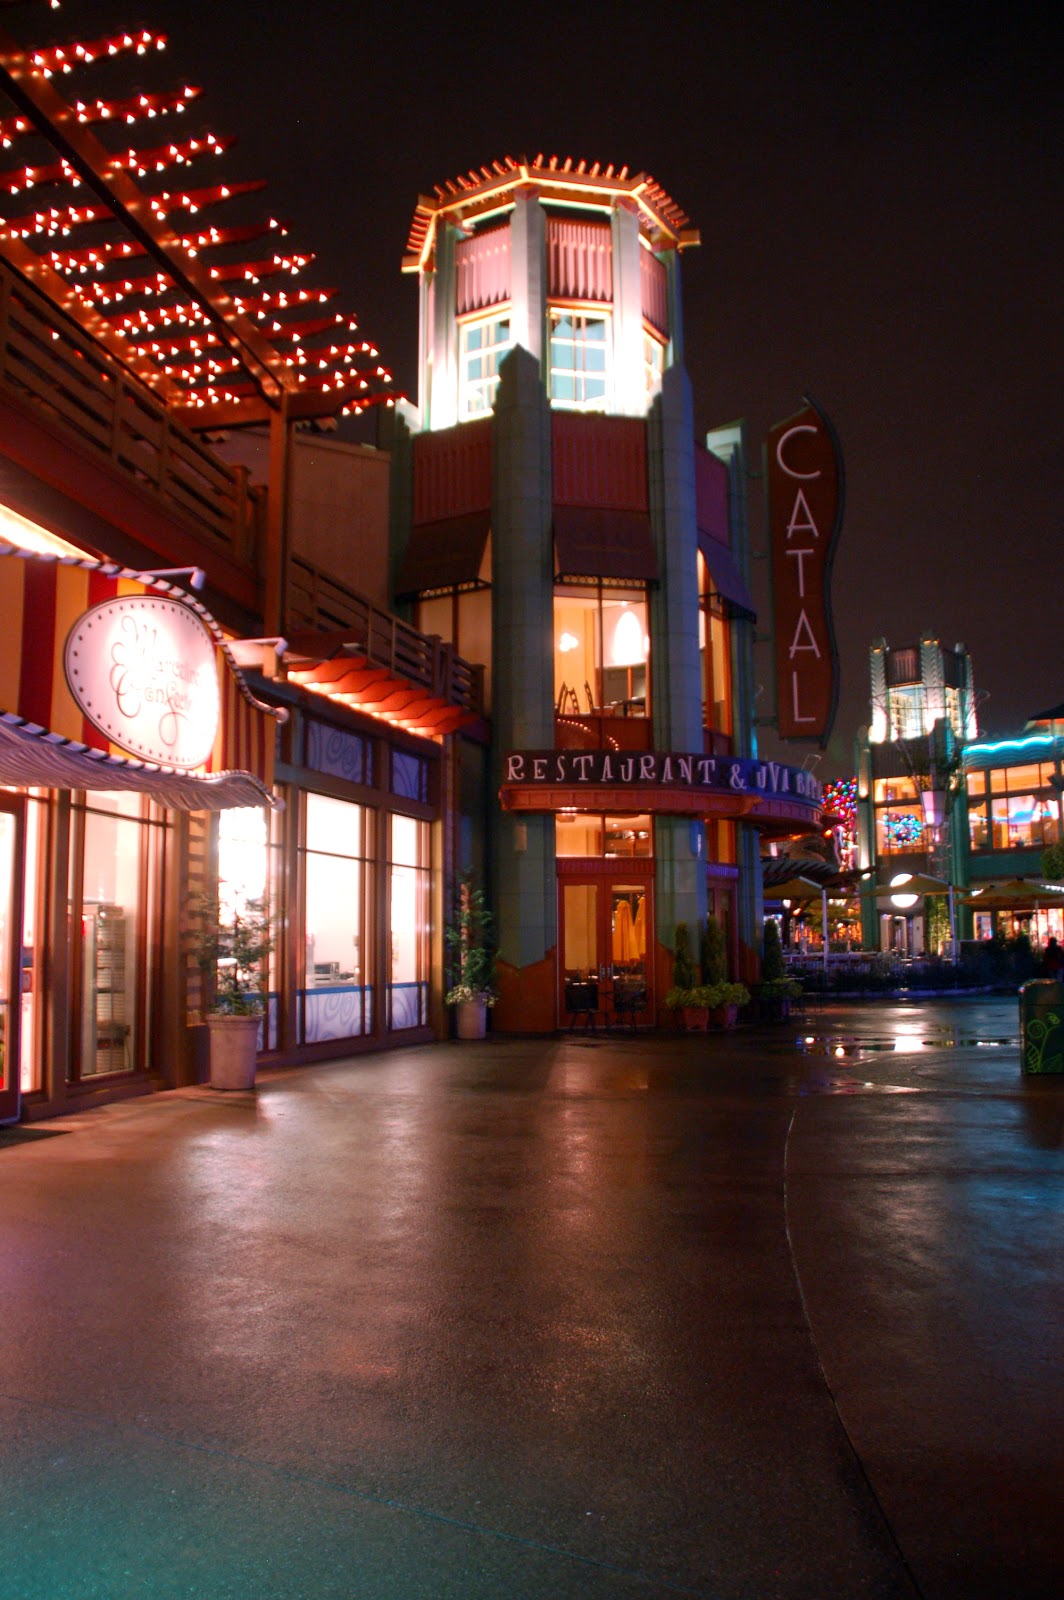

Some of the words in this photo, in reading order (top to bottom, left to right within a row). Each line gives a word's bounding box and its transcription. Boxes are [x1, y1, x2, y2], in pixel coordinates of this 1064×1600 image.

[776, 424, 822, 723] CATAL
[506, 754, 716, 785] RESTAURANT
[729, 763, 748, 790] &
[756, 761, 790, 793] UVA
